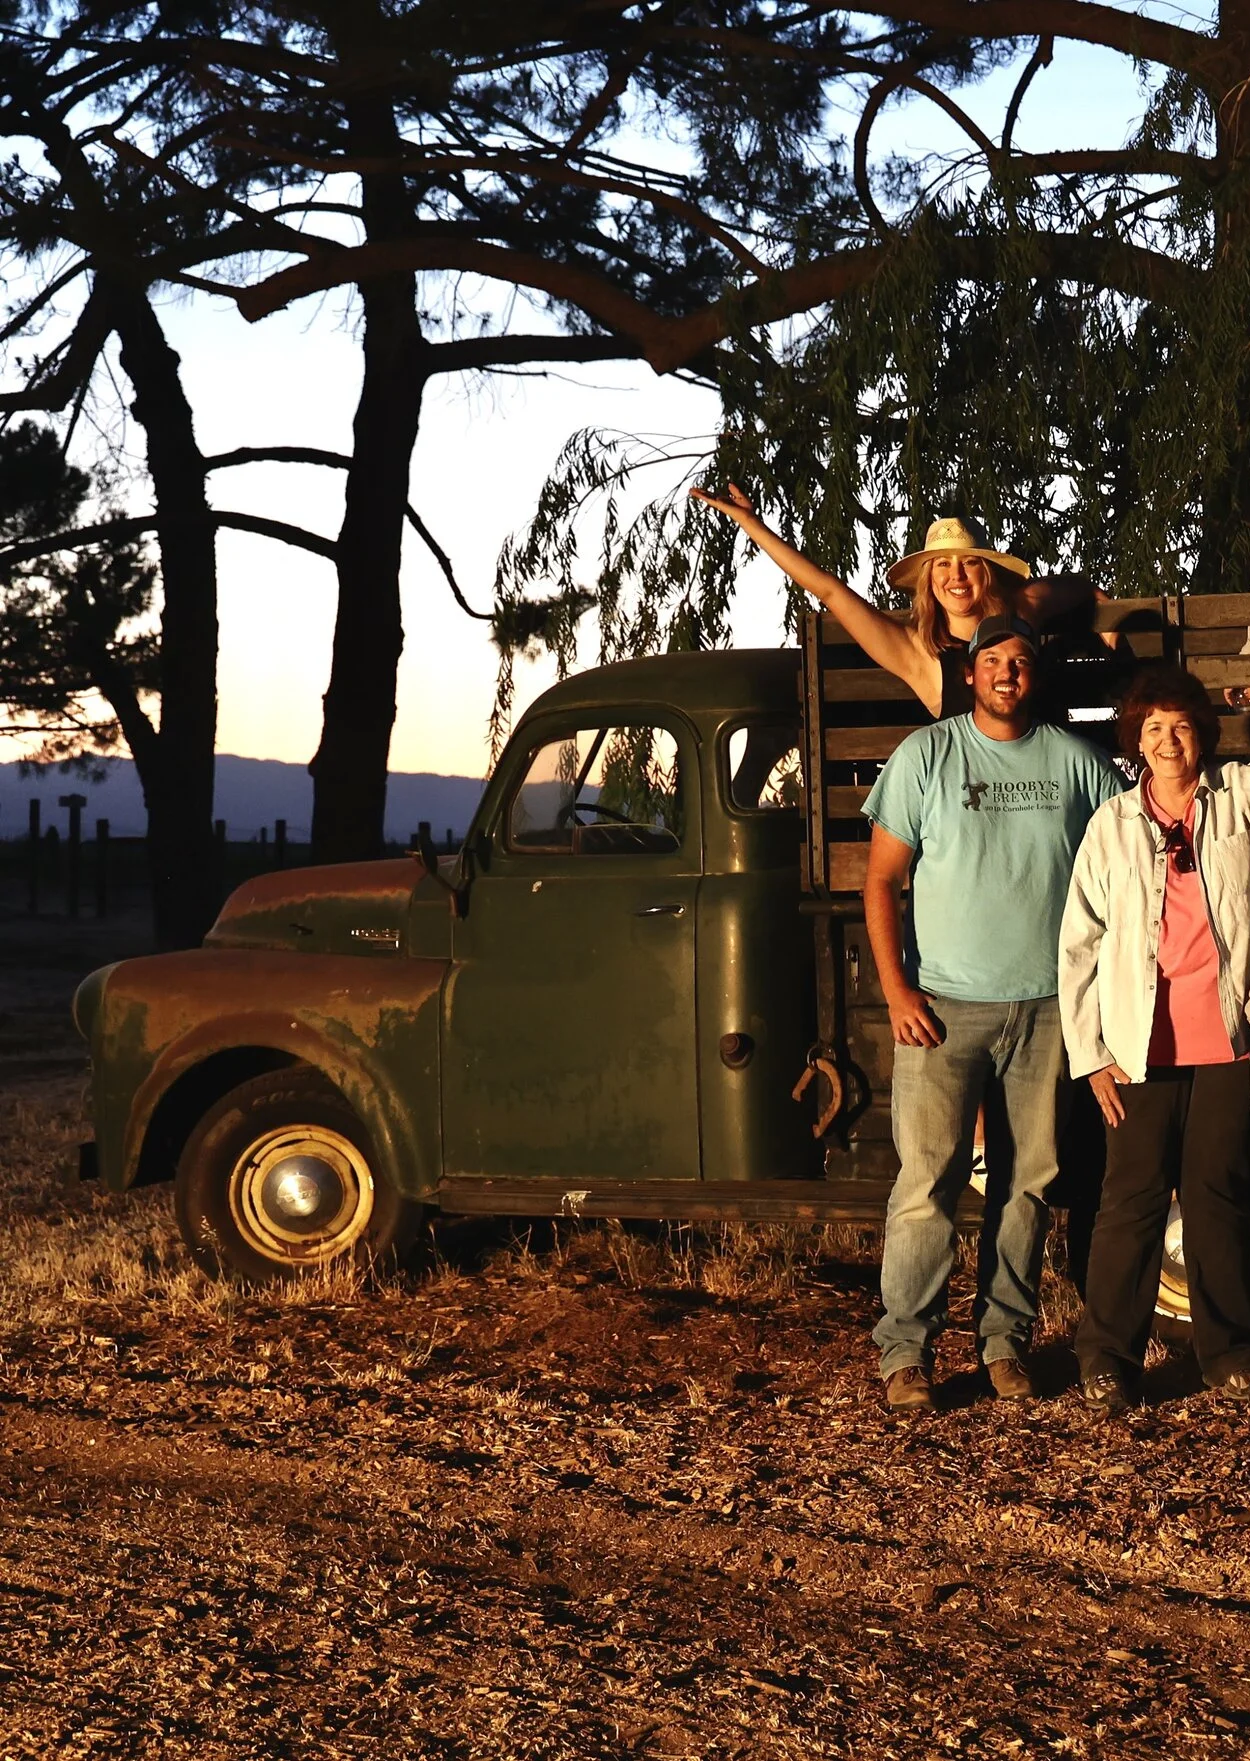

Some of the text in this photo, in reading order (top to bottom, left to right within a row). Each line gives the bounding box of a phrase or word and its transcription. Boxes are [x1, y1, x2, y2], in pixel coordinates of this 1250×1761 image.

[993, 781, 1059, 792] HOOBY'S
[993, 792, 1059, 802] BREWING
[1002, 804, 1035, 813] Cornhole
[1036, 803, 1061, 811] League
